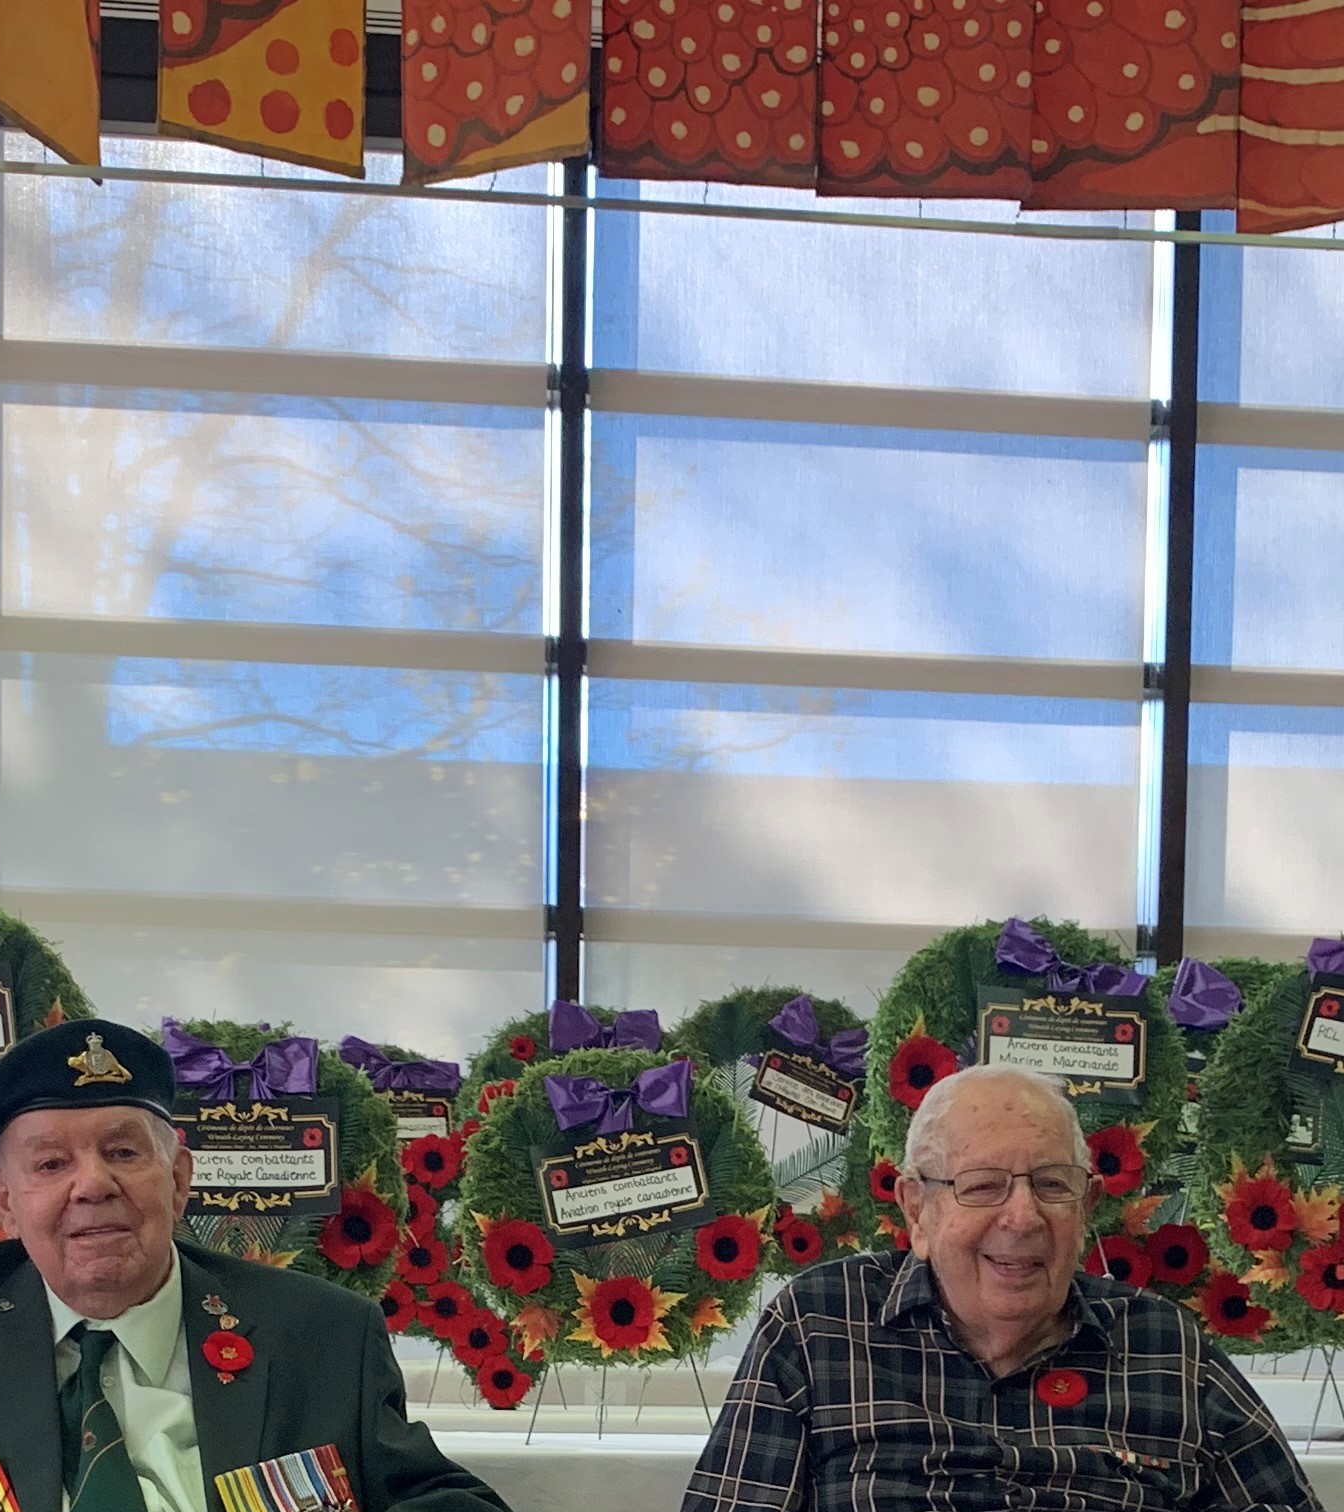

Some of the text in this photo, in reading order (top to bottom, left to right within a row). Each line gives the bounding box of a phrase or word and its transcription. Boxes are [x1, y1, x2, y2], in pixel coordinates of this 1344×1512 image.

[1316, 1024, 1341, 1042] RCL
[999, 1053, 1119, 1071] Marine Marchande
[192, 1154, 234, 1165] nciens
[256, 1167, 317, 1182] Canadienne
[565, 1186, 607, 1202] Anciens
[560, 1203, 599, 1220] Aviation
